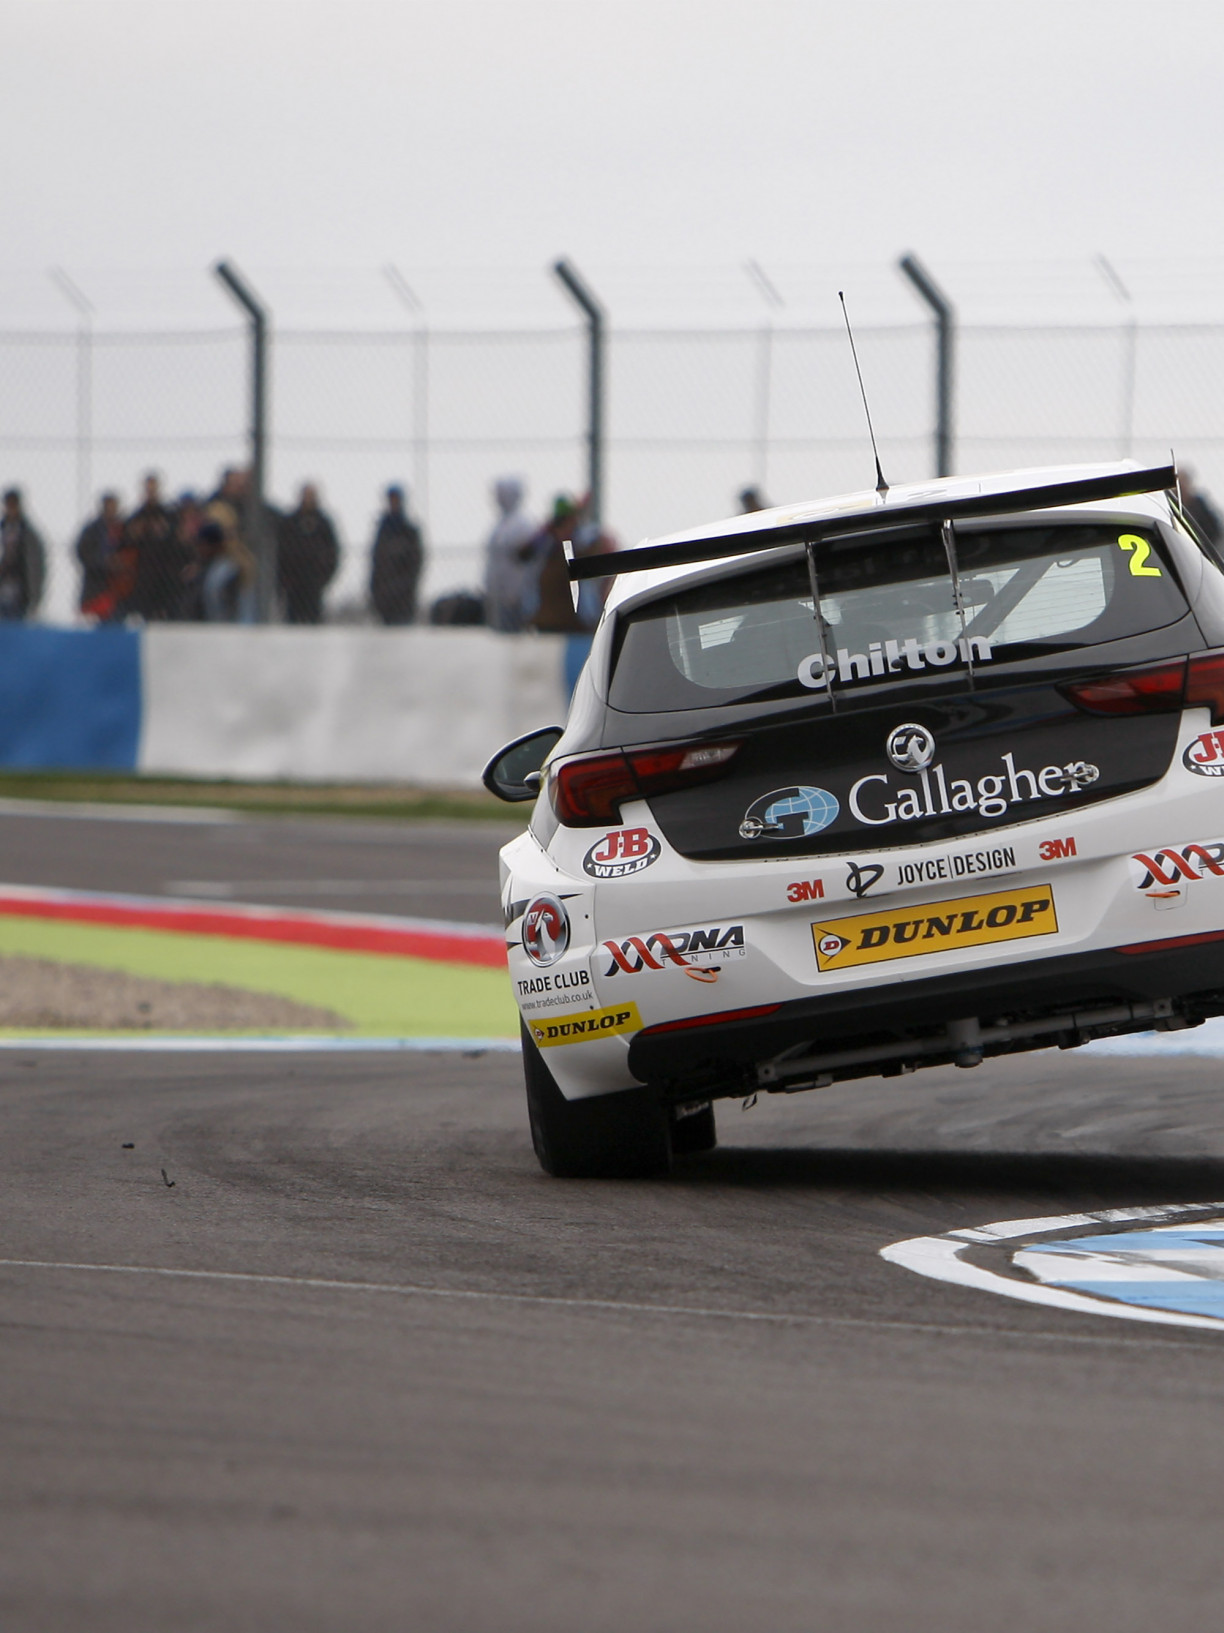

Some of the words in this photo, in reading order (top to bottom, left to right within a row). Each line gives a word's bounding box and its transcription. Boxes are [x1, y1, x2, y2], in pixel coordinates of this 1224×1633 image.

[1117, 534, 1162, 577] 2
[797, 635, 993, 689] Chilton
[849, 751, 1088, 826] Gallagher
[1039, 836, 1078, 862] 3M
[593, 858, 649, 878] WELD
[786, 878, 826, 904] 3M
[855, 898, 1051, 950] DUNLOP
[661, 948, 746, 967] TNING
[517, 976, 552, 996] TRADE
[554, 970, 590, 989] CLUB
[520, 989, 595, 1011] www.tradeclub.co.uk
[546, 1011, 632, 1039] DUNLOP
